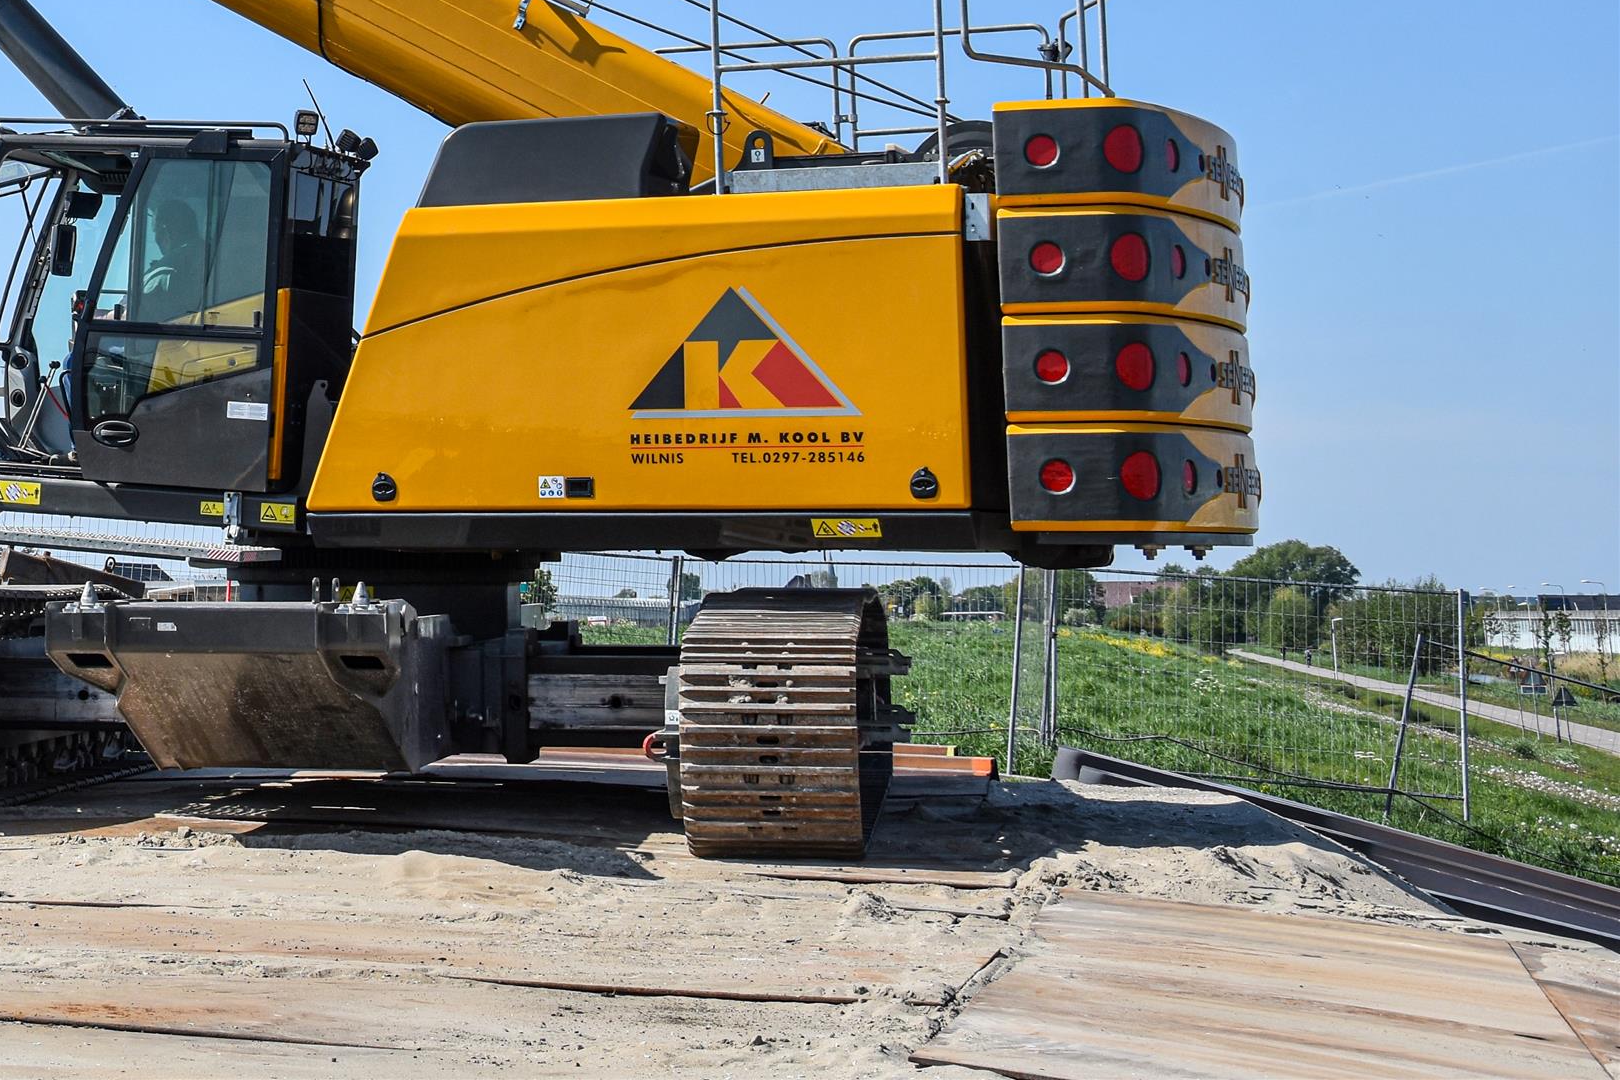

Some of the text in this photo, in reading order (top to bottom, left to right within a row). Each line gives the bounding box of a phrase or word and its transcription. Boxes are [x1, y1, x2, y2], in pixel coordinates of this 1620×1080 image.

[630, 431, 864, 445] HEIBEDRIJF M. KOOL BV
[631, 451, 865, 464] WILNIS TEL.0297-285146
